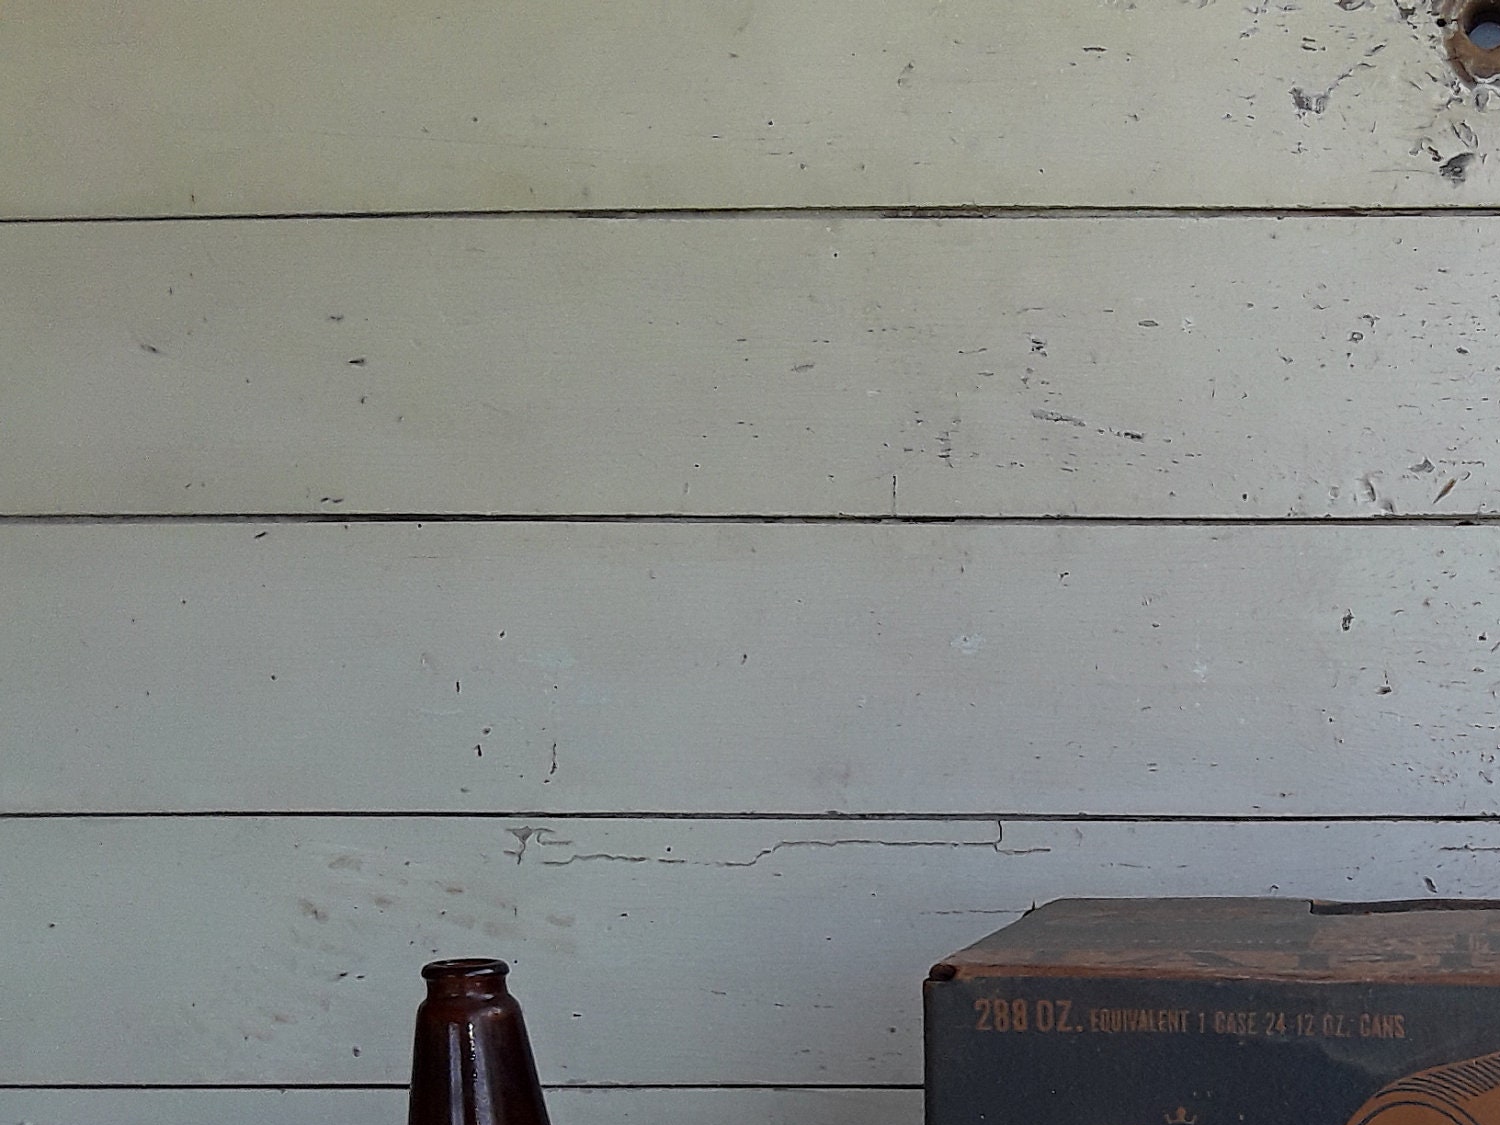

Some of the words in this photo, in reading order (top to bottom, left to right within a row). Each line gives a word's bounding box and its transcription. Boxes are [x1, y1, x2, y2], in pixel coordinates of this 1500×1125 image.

[974, 999, 1028, 1032] 288
[1036, 1000, 1083, 1032] OZ.
[1089, 1008, 1188, 1033] EQUIVALENT
[1198, 1013, 1206, 1033] 1
[1215, 1011, 1257, 1035] CASE
[1359, 1013, 1405, 1038] CANS
